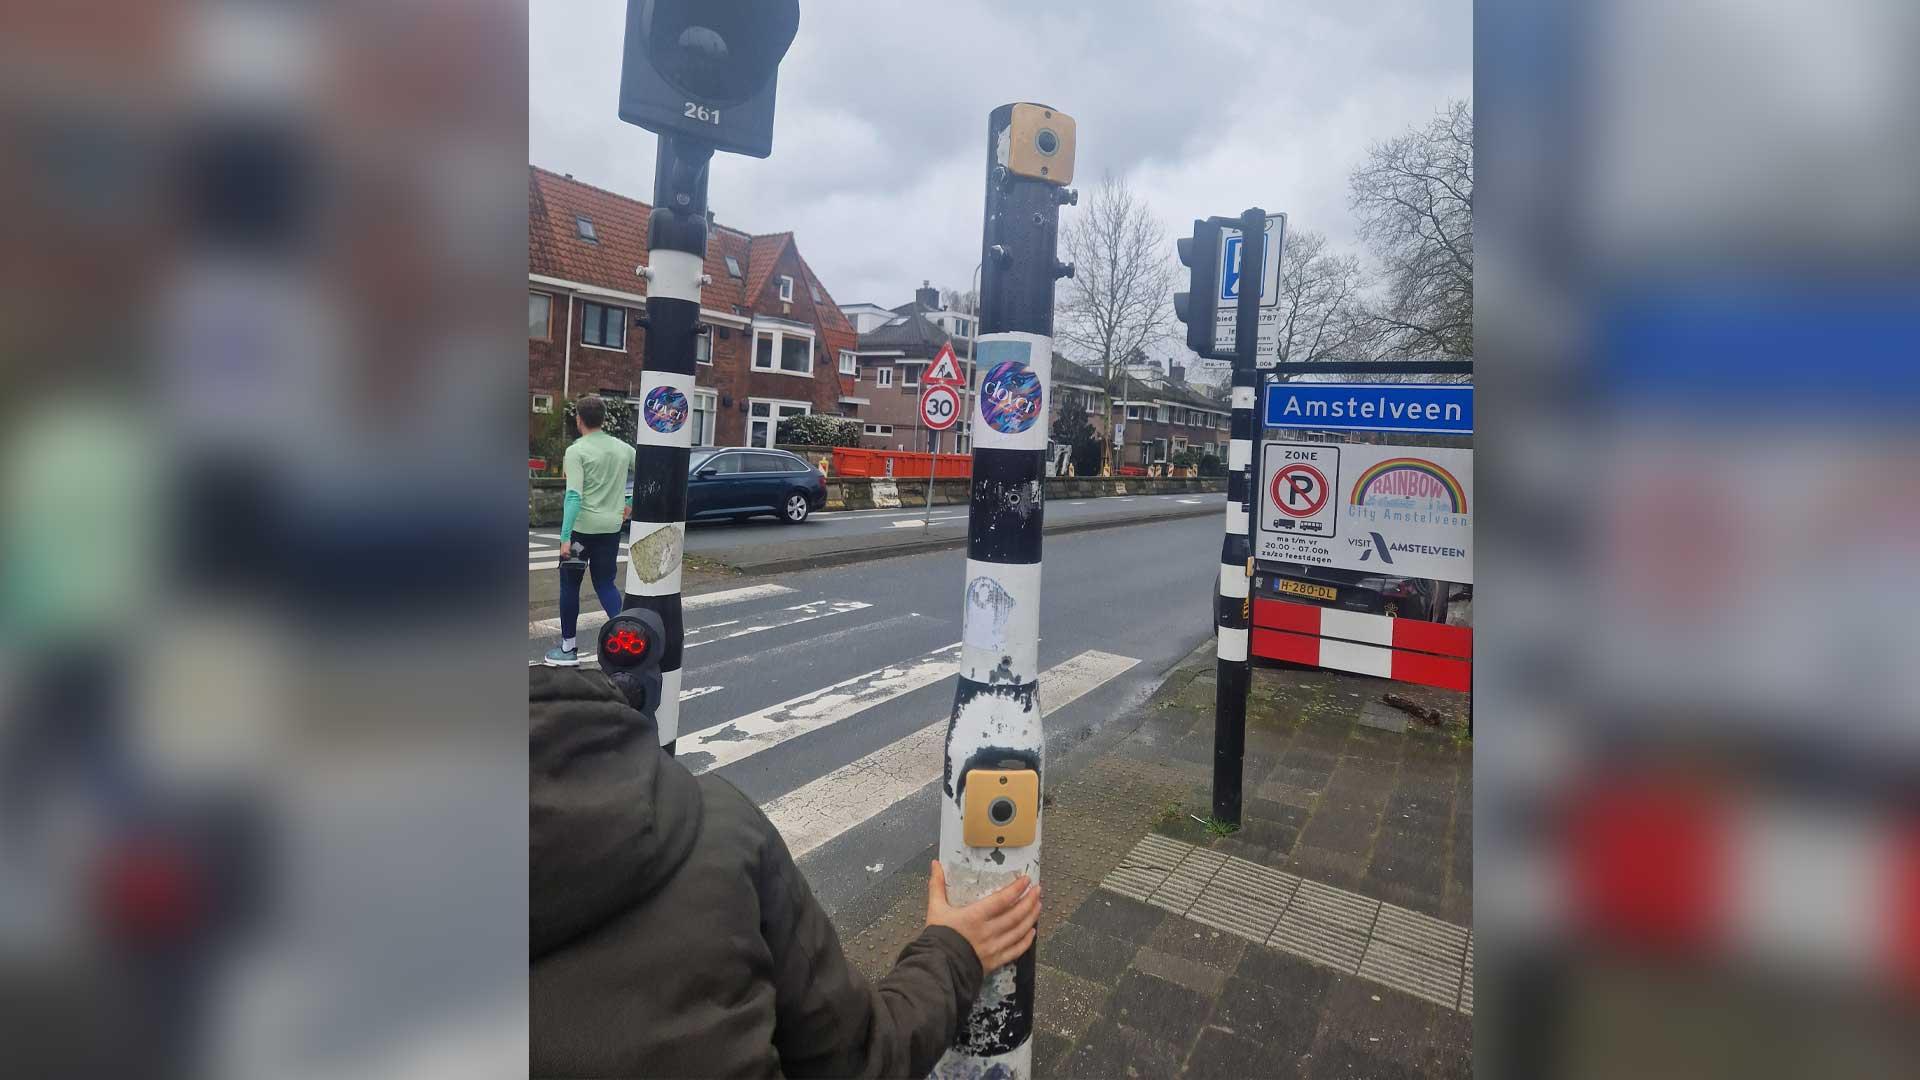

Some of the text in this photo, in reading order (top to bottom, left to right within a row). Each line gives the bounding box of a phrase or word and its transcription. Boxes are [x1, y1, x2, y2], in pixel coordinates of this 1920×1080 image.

[684, 102, 719, 125] 261
[927, 399, 953, 417] 30
[1283, 395, 1461, 421] Amstelveen
[1285, 451, 1317, 460] ZONE
[1373, 470, 1443, 498] RAINBOW
[1348, 505, 1467, 527] City Amstelveen
[1265, 542, 1290, 551] 20.00
[1298, 546, 1329, 555] 07.00h
[1292, 536, 1306, 545] t/m
[1348, 538, 1465, 558] VISIT AMSTELVEEN
[1285, 552, 1332, 564] feestdagen
[1281, 583, 1333, 599] H-280-DL
